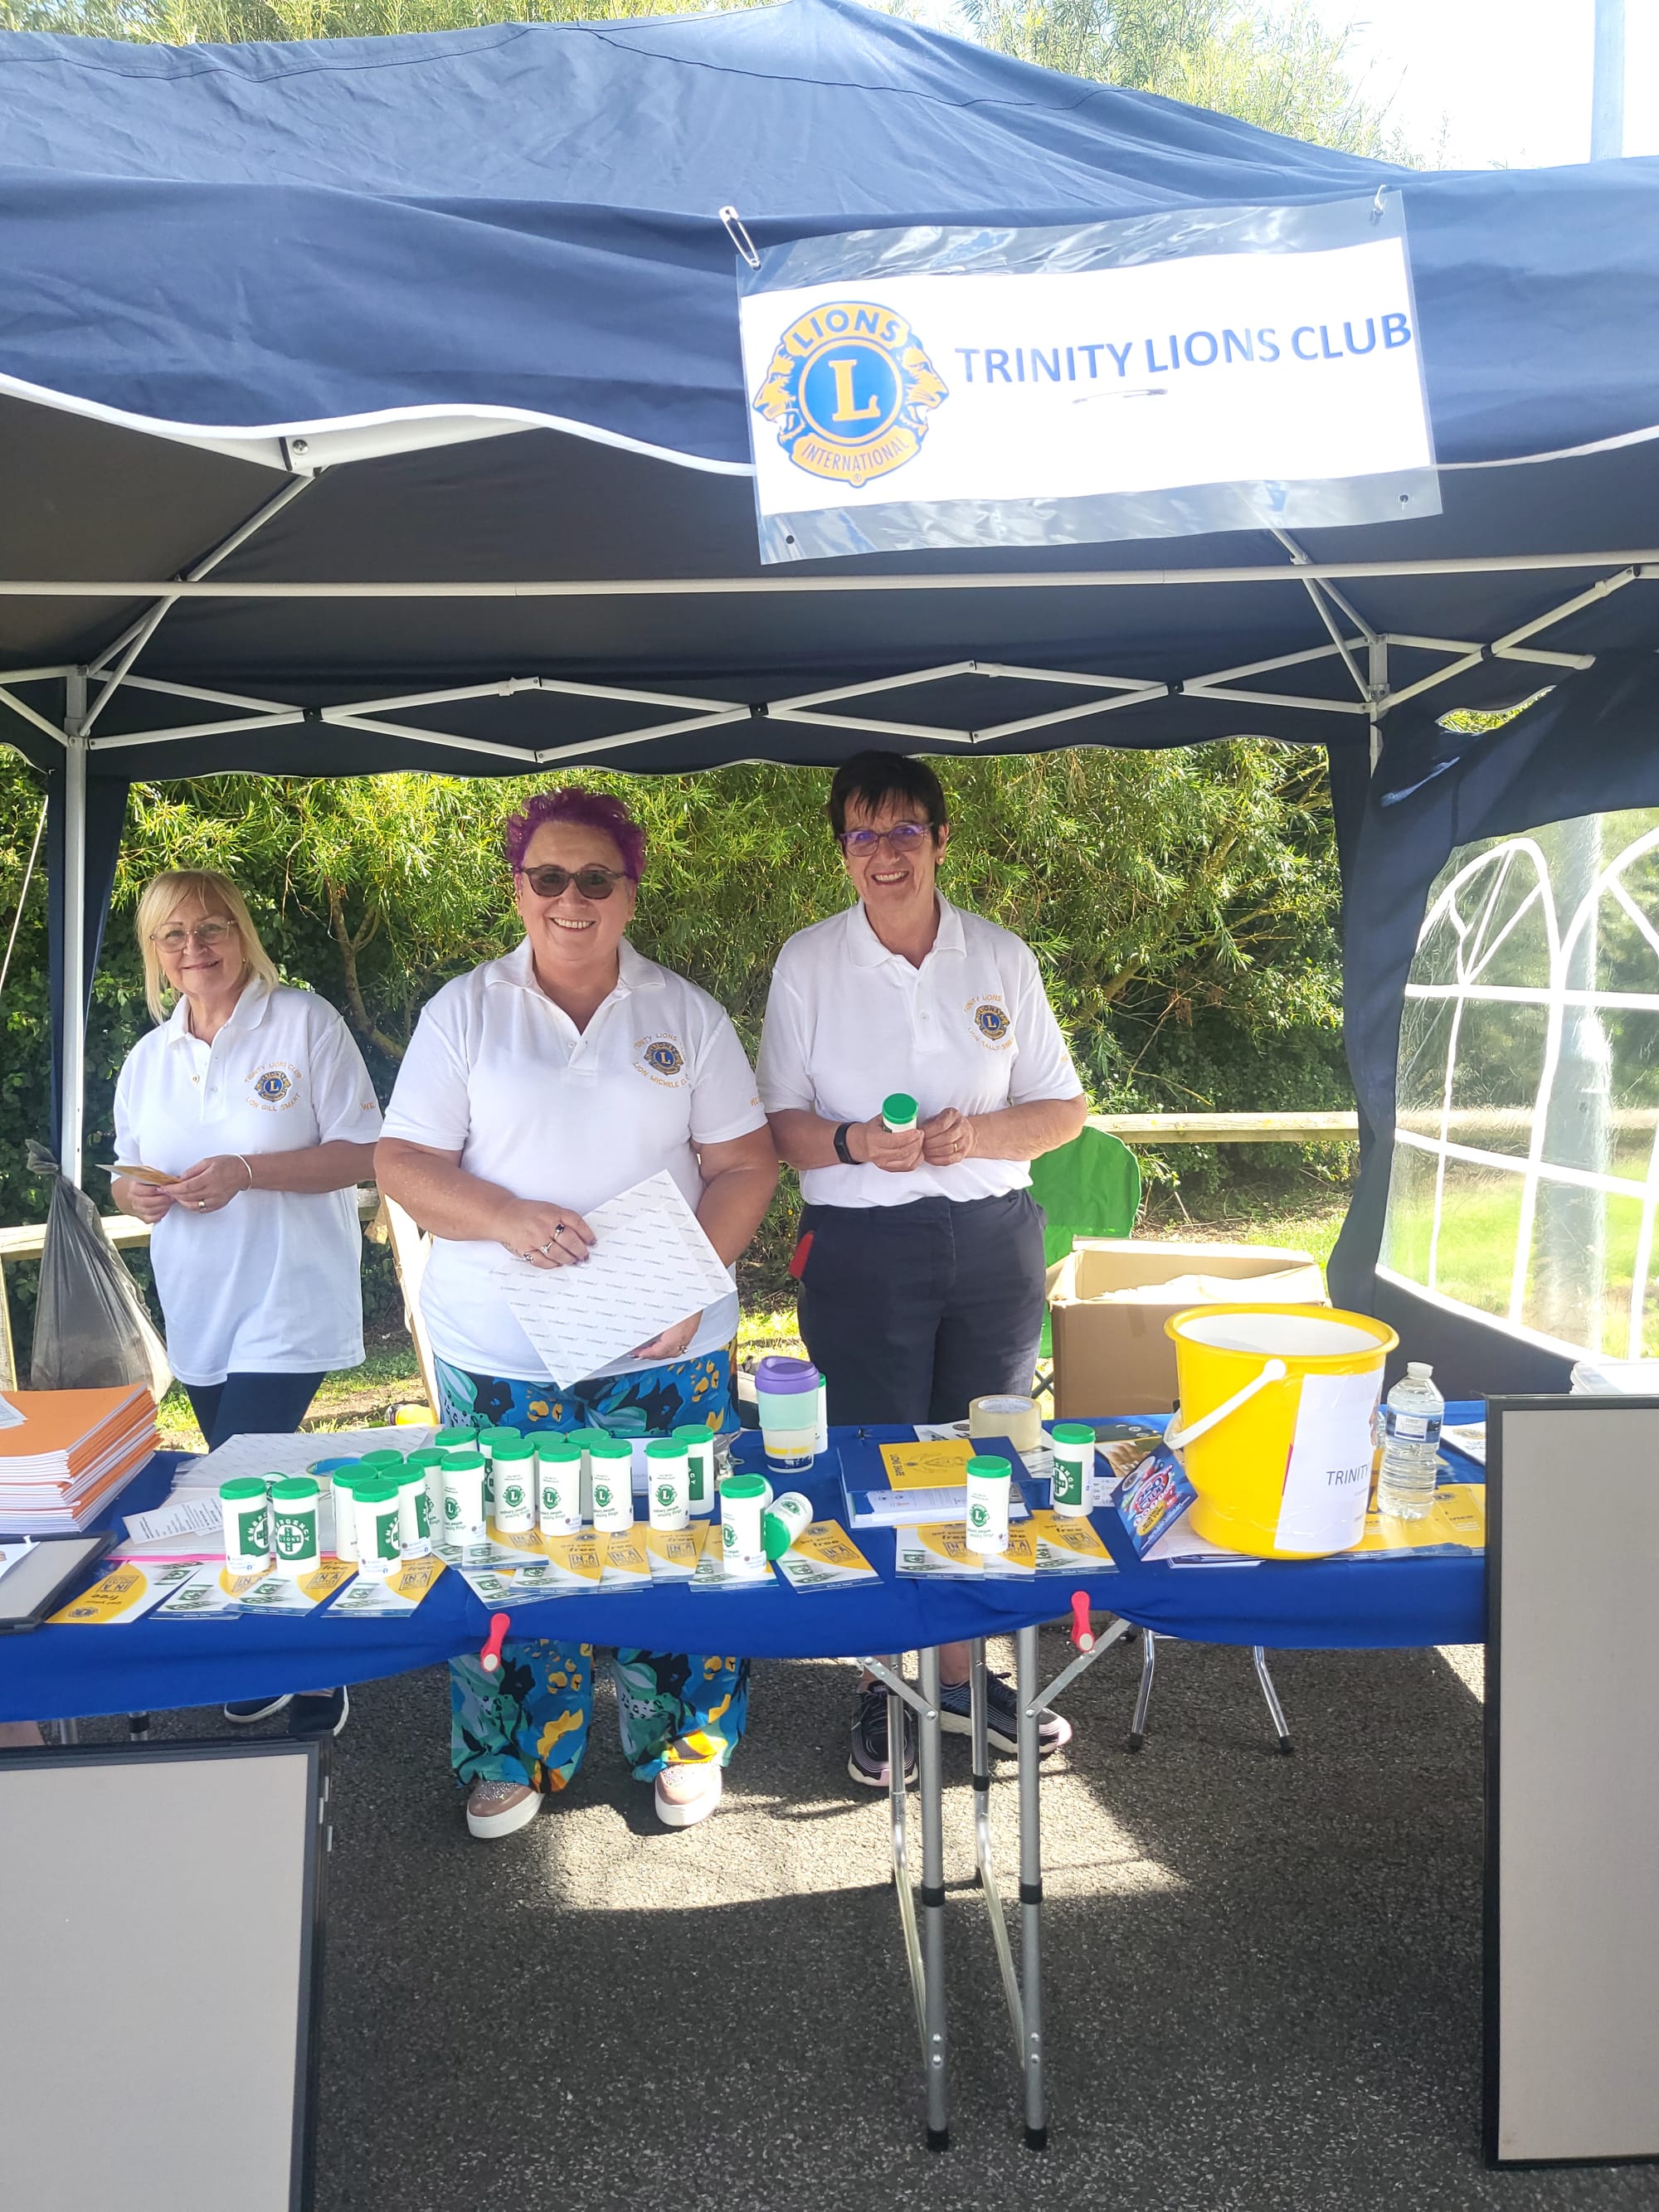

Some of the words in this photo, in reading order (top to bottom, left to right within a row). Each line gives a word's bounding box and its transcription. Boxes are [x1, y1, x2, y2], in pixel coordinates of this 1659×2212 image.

[791, 309, 902, 351] LIONS
[955, 343, 1133, 384] TRINITY
[1144, 328, 1281, 373] LIONS
[1291, 312, 1412, 361] CLUB
[828, 358, 882, 422] L
[800, 435, 910, 473] INTERNATIONAL
[985, 1015, 997, 1028] L
[659, 1052, 671, 1065] L
[287, 1063, 303, 1080] CLUB
[269, 1080, 280, 1092] L
[649, 1076, 680, 1088] MICHELE
[260, 1104, 278, 1113] GILL
[280, 1092, 301, 1112] SMART
[1326, 1464, 1368, 1485] TRINIT
[975, 1510, 983, 1521] L
